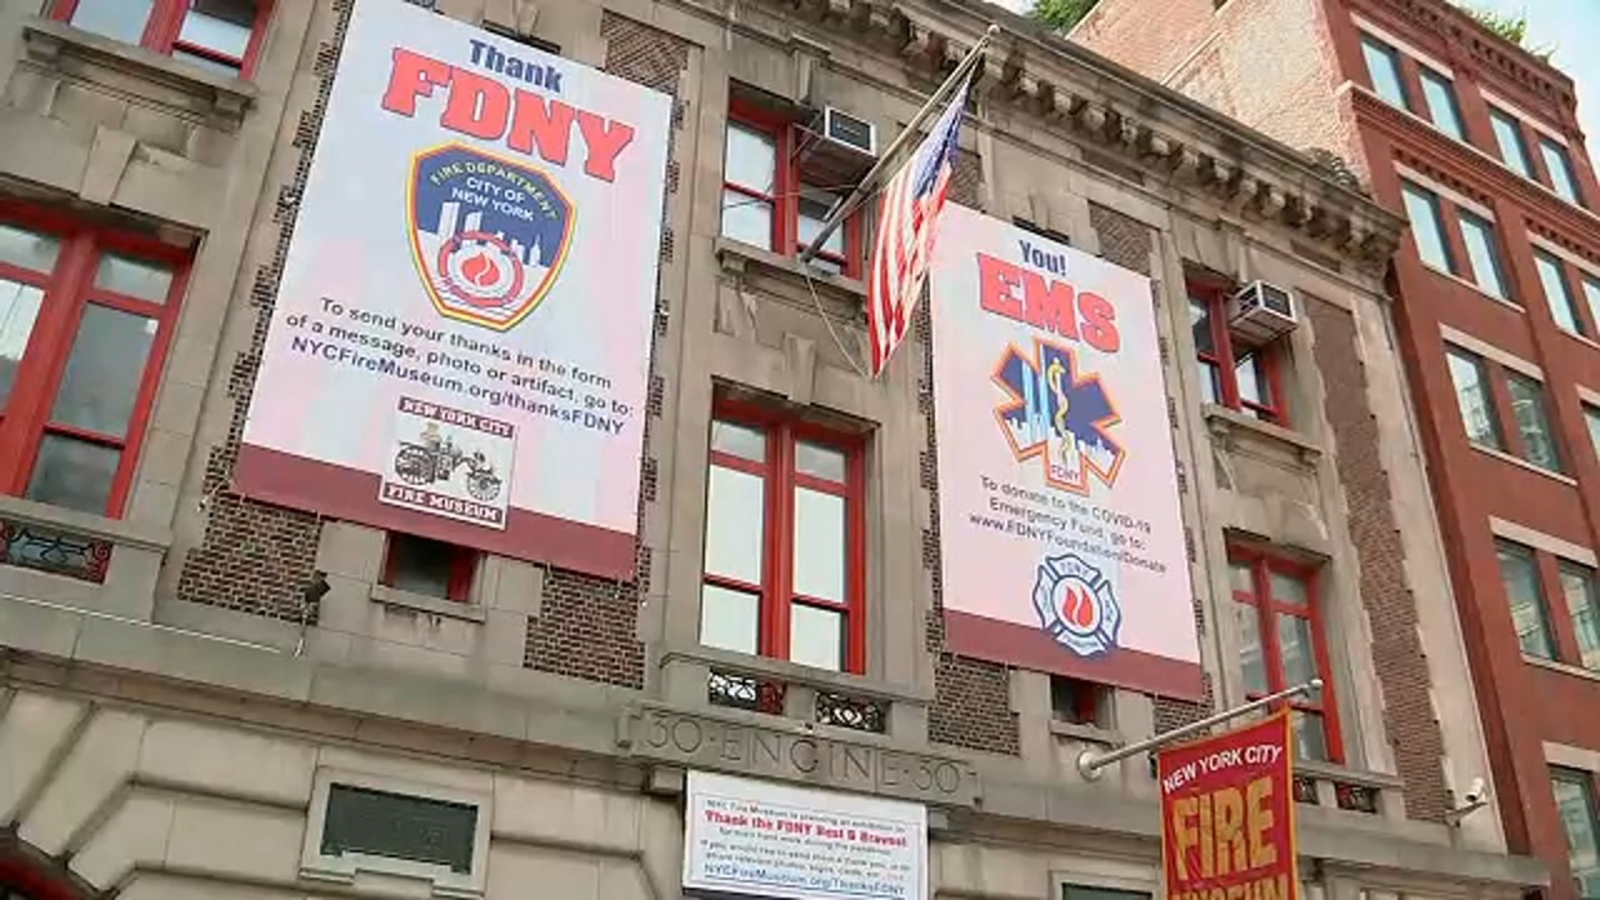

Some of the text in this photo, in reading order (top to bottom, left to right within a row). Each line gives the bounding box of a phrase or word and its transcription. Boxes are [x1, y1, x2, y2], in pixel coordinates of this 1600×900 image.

[469, 39, 562, 93] Thank
[381, 46, 635, 183] FDNY
[430, 161, 560, 219] FIRE DEPARTMENT
[451, 187, 535, 221] NEW YORK
[465, 177, 526, 202] CITY OF
[1018, 239, 1067, 276] You!
[976, 251, 1121, 353] EMS
[286, 312, 635, 417] of a message, photo or artifact, go to:
[321, 297, 613, 390] To send your thanks in the form
[290, 335, 625, 436] NYCFireMuseum.org/thanksFDNY
[403, 398, 512, 437] NEW YORK CITY
[979, 474, 998, 491] To
[1001, 482, 1049, 504] donate
[1051, 495, 1066, 509] to
[1068, 499, 1088, 515] the
[1050, 464, 1080, 482] FDNY
[388, 484, 500, 522] FIRE MUSEUM
[989, 498, 1068, 531] Emergency
[1110, 531, 1128, 547] go
[719, 726, 900, 787] ENGINE
[1162, 744, 1284, 795] NEW YORK CITY
[704, 809, 748, 827] Thank
[751, 816, 773, 831] the
[776, 819, 812, 836] FDNY
[815, 824, 844, 839] Best
[1173, 774, 1278, 881] FIRE
